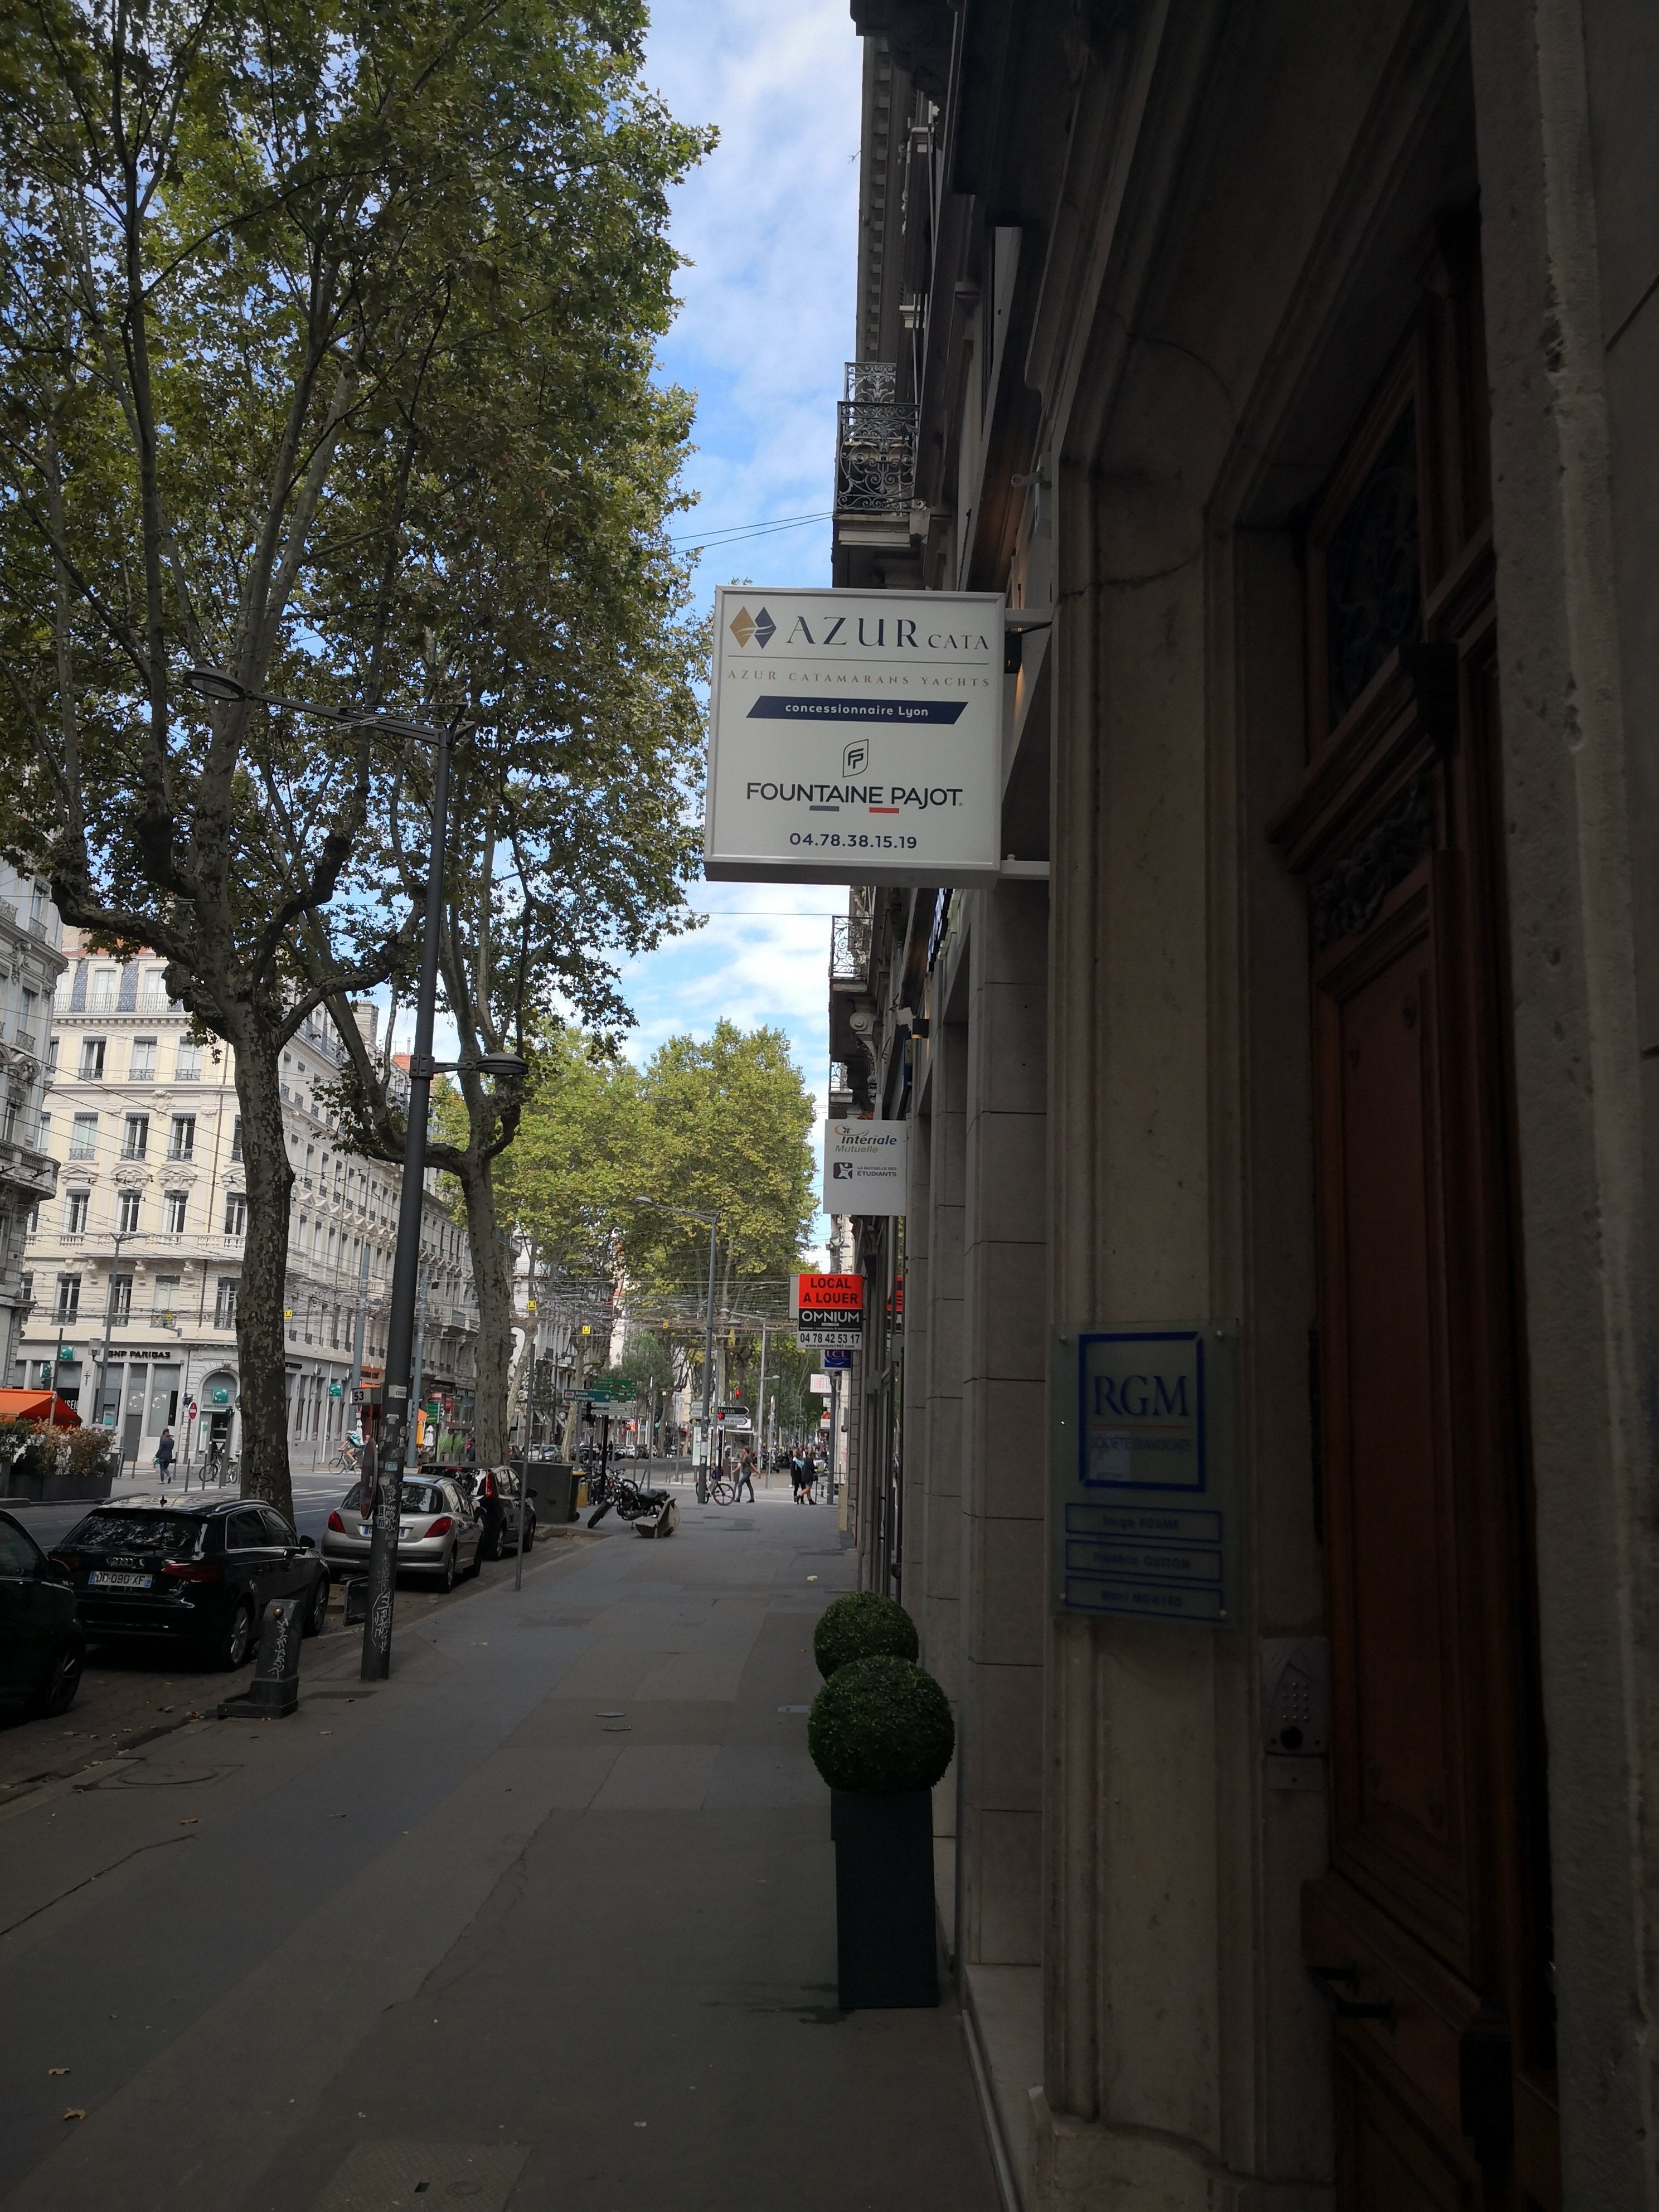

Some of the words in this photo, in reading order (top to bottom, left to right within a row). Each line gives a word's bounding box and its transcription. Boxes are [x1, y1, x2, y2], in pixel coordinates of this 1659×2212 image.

[786, 615, 919, 648] AZUR
[928, 634, 989, 650] CATA
[727, 670, 777, 680] AZUR
[789, 673, 909, 684] CATAMARANS
[921, 677, 989, 687] YACHTS
[785, 703, 893, 716] concessionnaire
[898, 706, 928, 719] Lyon
[746, 783, 883, 804] FOUNTAINE
[891, 787, 963, 809] PAJOT
[789, 833, 916, 849] 04.78.38.15.19
[835, 1144, 878, 1153] Mutuelle
[811, 1278, 851, 1288] LOCAL
[803, 1293, 811, 1303] A
[816, 1293, 858, 1304] LOUER
[802, 1311, 859, 1323] OMNIUM
[800, 1333, 810, 1343] 04
[813, 1333, 822, 1343] 78
[825, 1333, 835, 1343] 42
[837, 1333, 847, 1343] 53
[851, 1334, 860, 1343] 17
[129, 1351, 171, 1359] PARIBAS
[826, 1350, 846, 1358] LCL
[354, 1391, 364, 1401] 53
[1093, 1375, 1189, 1417] RGM
